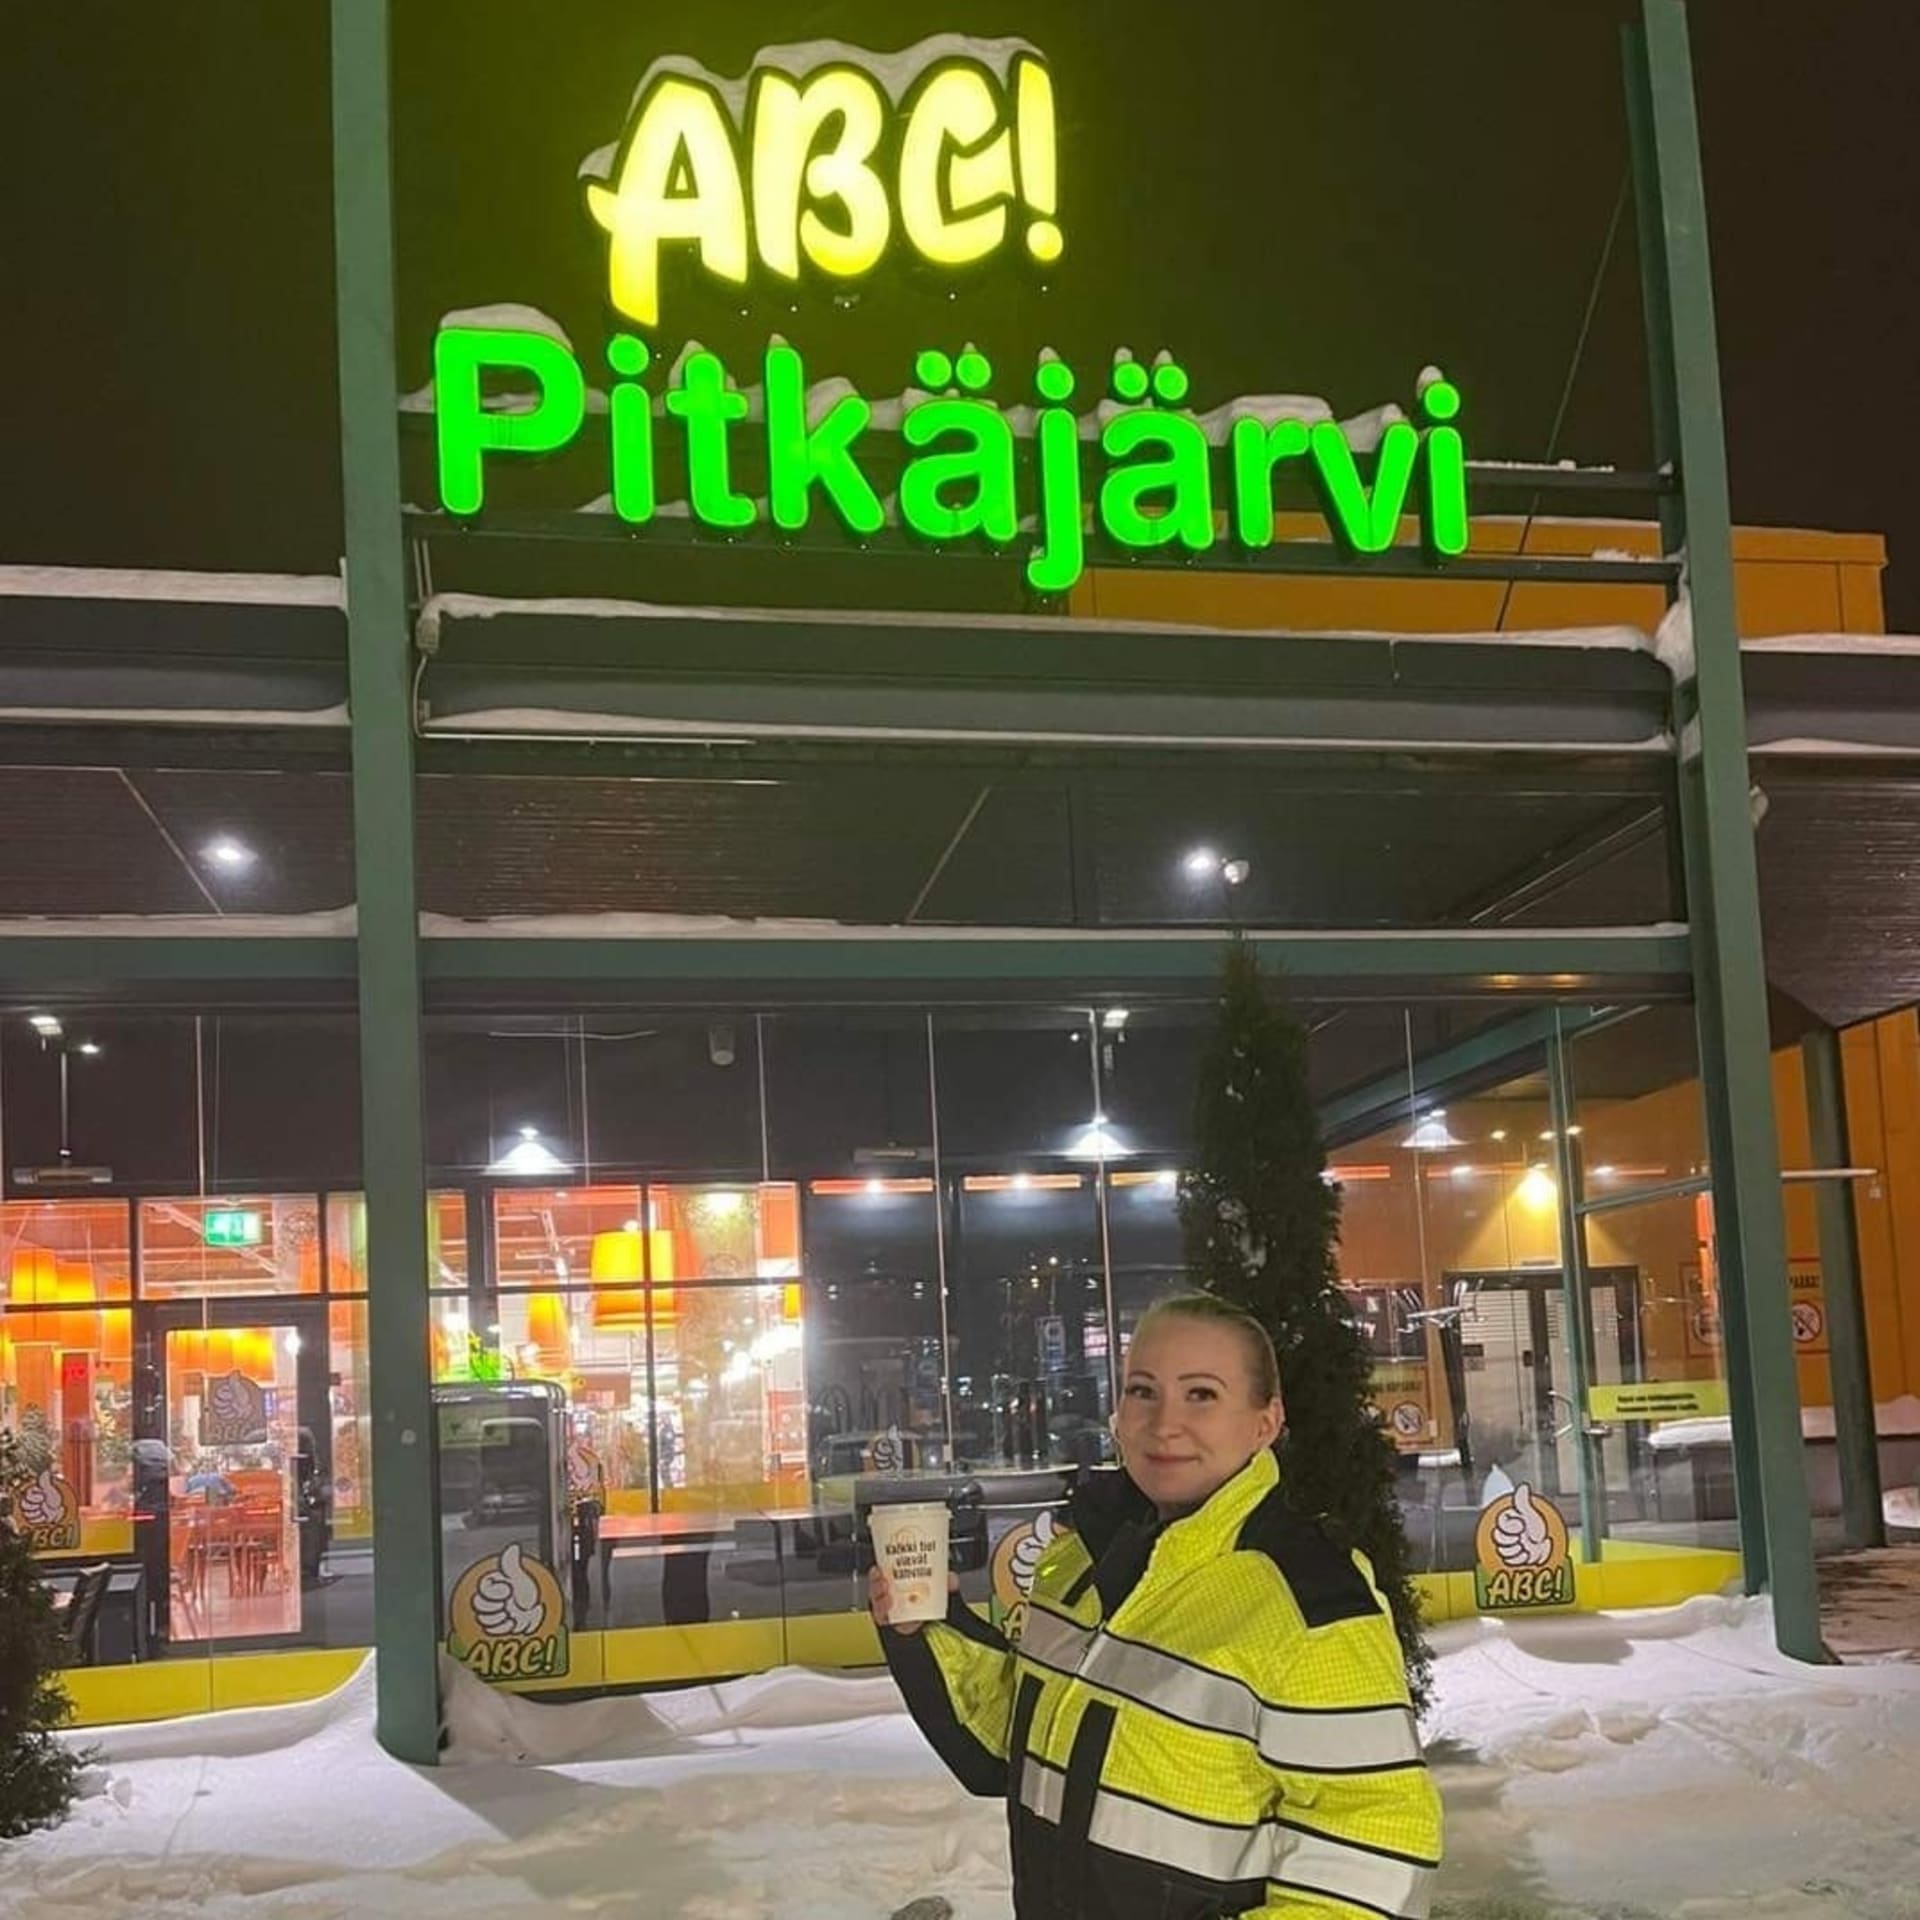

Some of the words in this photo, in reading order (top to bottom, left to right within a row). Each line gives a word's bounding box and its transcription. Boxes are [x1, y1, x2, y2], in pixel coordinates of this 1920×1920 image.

[587, 59, 1064, 327] ABC!
[434, 328, 1468, 591] Pitkäjärvi
[467, 1636, 556, 1675] ABC!
[1487, 1567, 1564, 1605] ABC!
